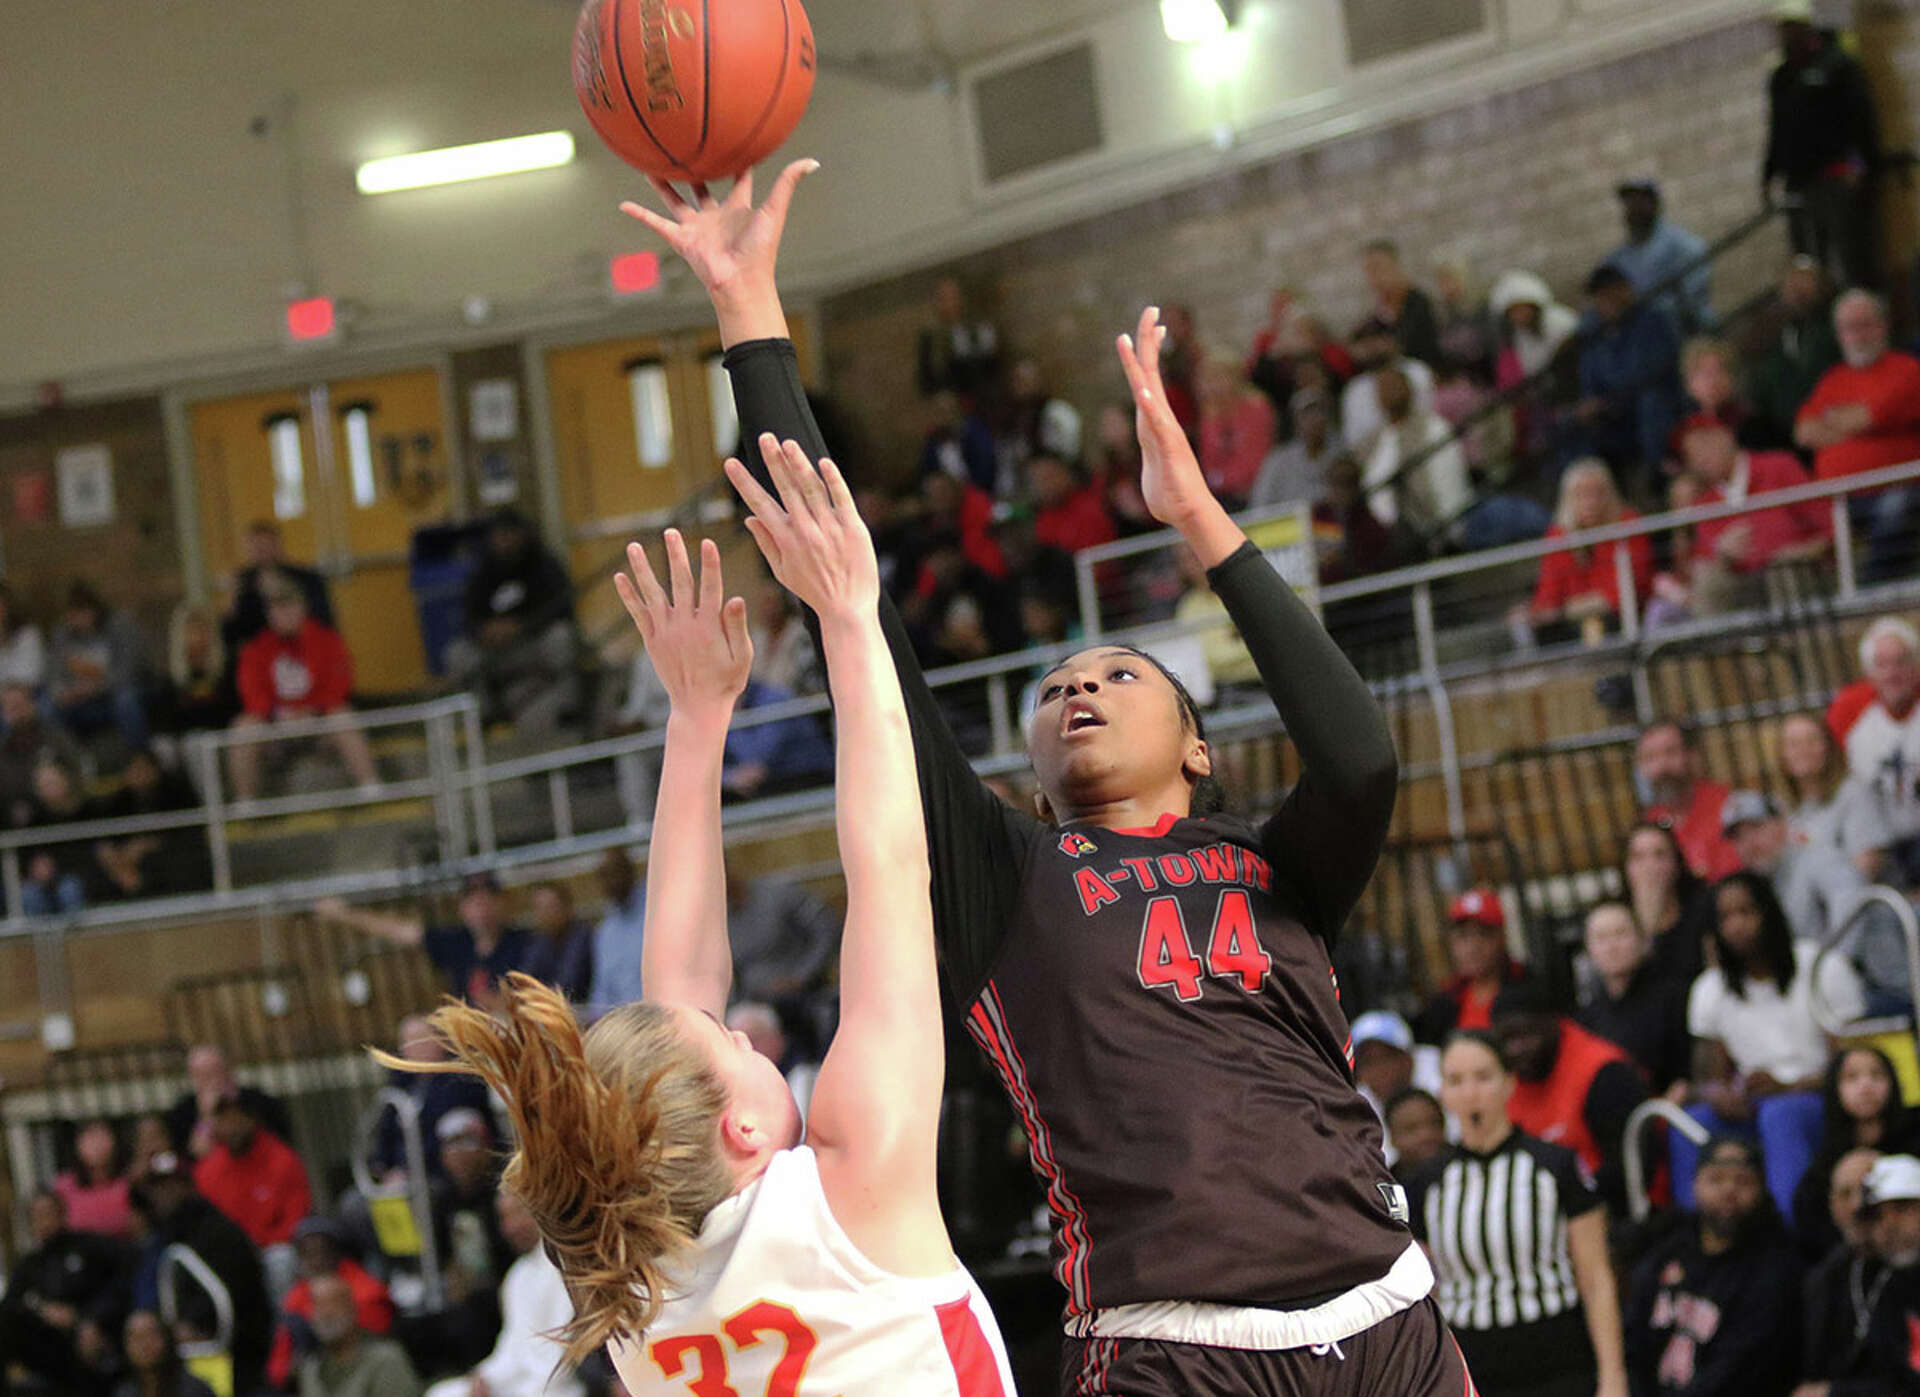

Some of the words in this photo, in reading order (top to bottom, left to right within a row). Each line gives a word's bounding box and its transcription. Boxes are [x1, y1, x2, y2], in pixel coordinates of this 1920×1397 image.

[1073, 842, 1273, 916] A-TOWN
[1136, 888, 1272, 1003] 44
[650, 1297, 821, 1397] 32
